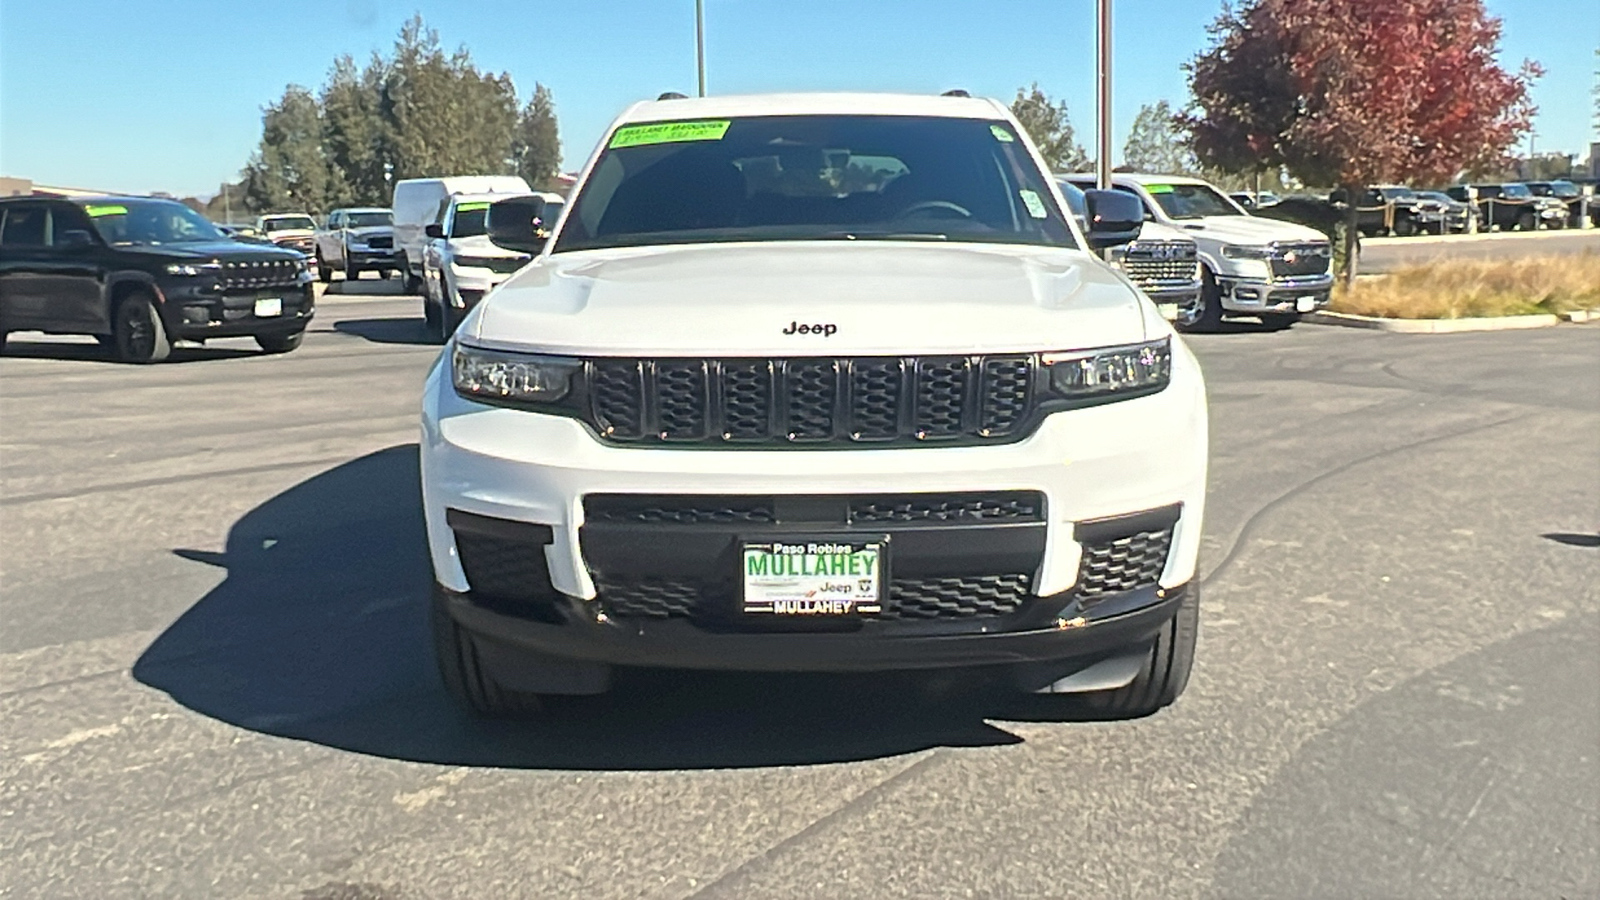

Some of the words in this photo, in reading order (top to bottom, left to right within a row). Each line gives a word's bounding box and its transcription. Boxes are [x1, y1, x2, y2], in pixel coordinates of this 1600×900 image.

[783, 321, 837, 338] Jeep
[773, 543, 805, 554] Paso
[808, 543, 852, 554] Robles
[748, 555, 877, 576] MULLAHEY
[820, 582, 852, 594] Jeep
[773, 600, 853, 614] MULLAHEY
